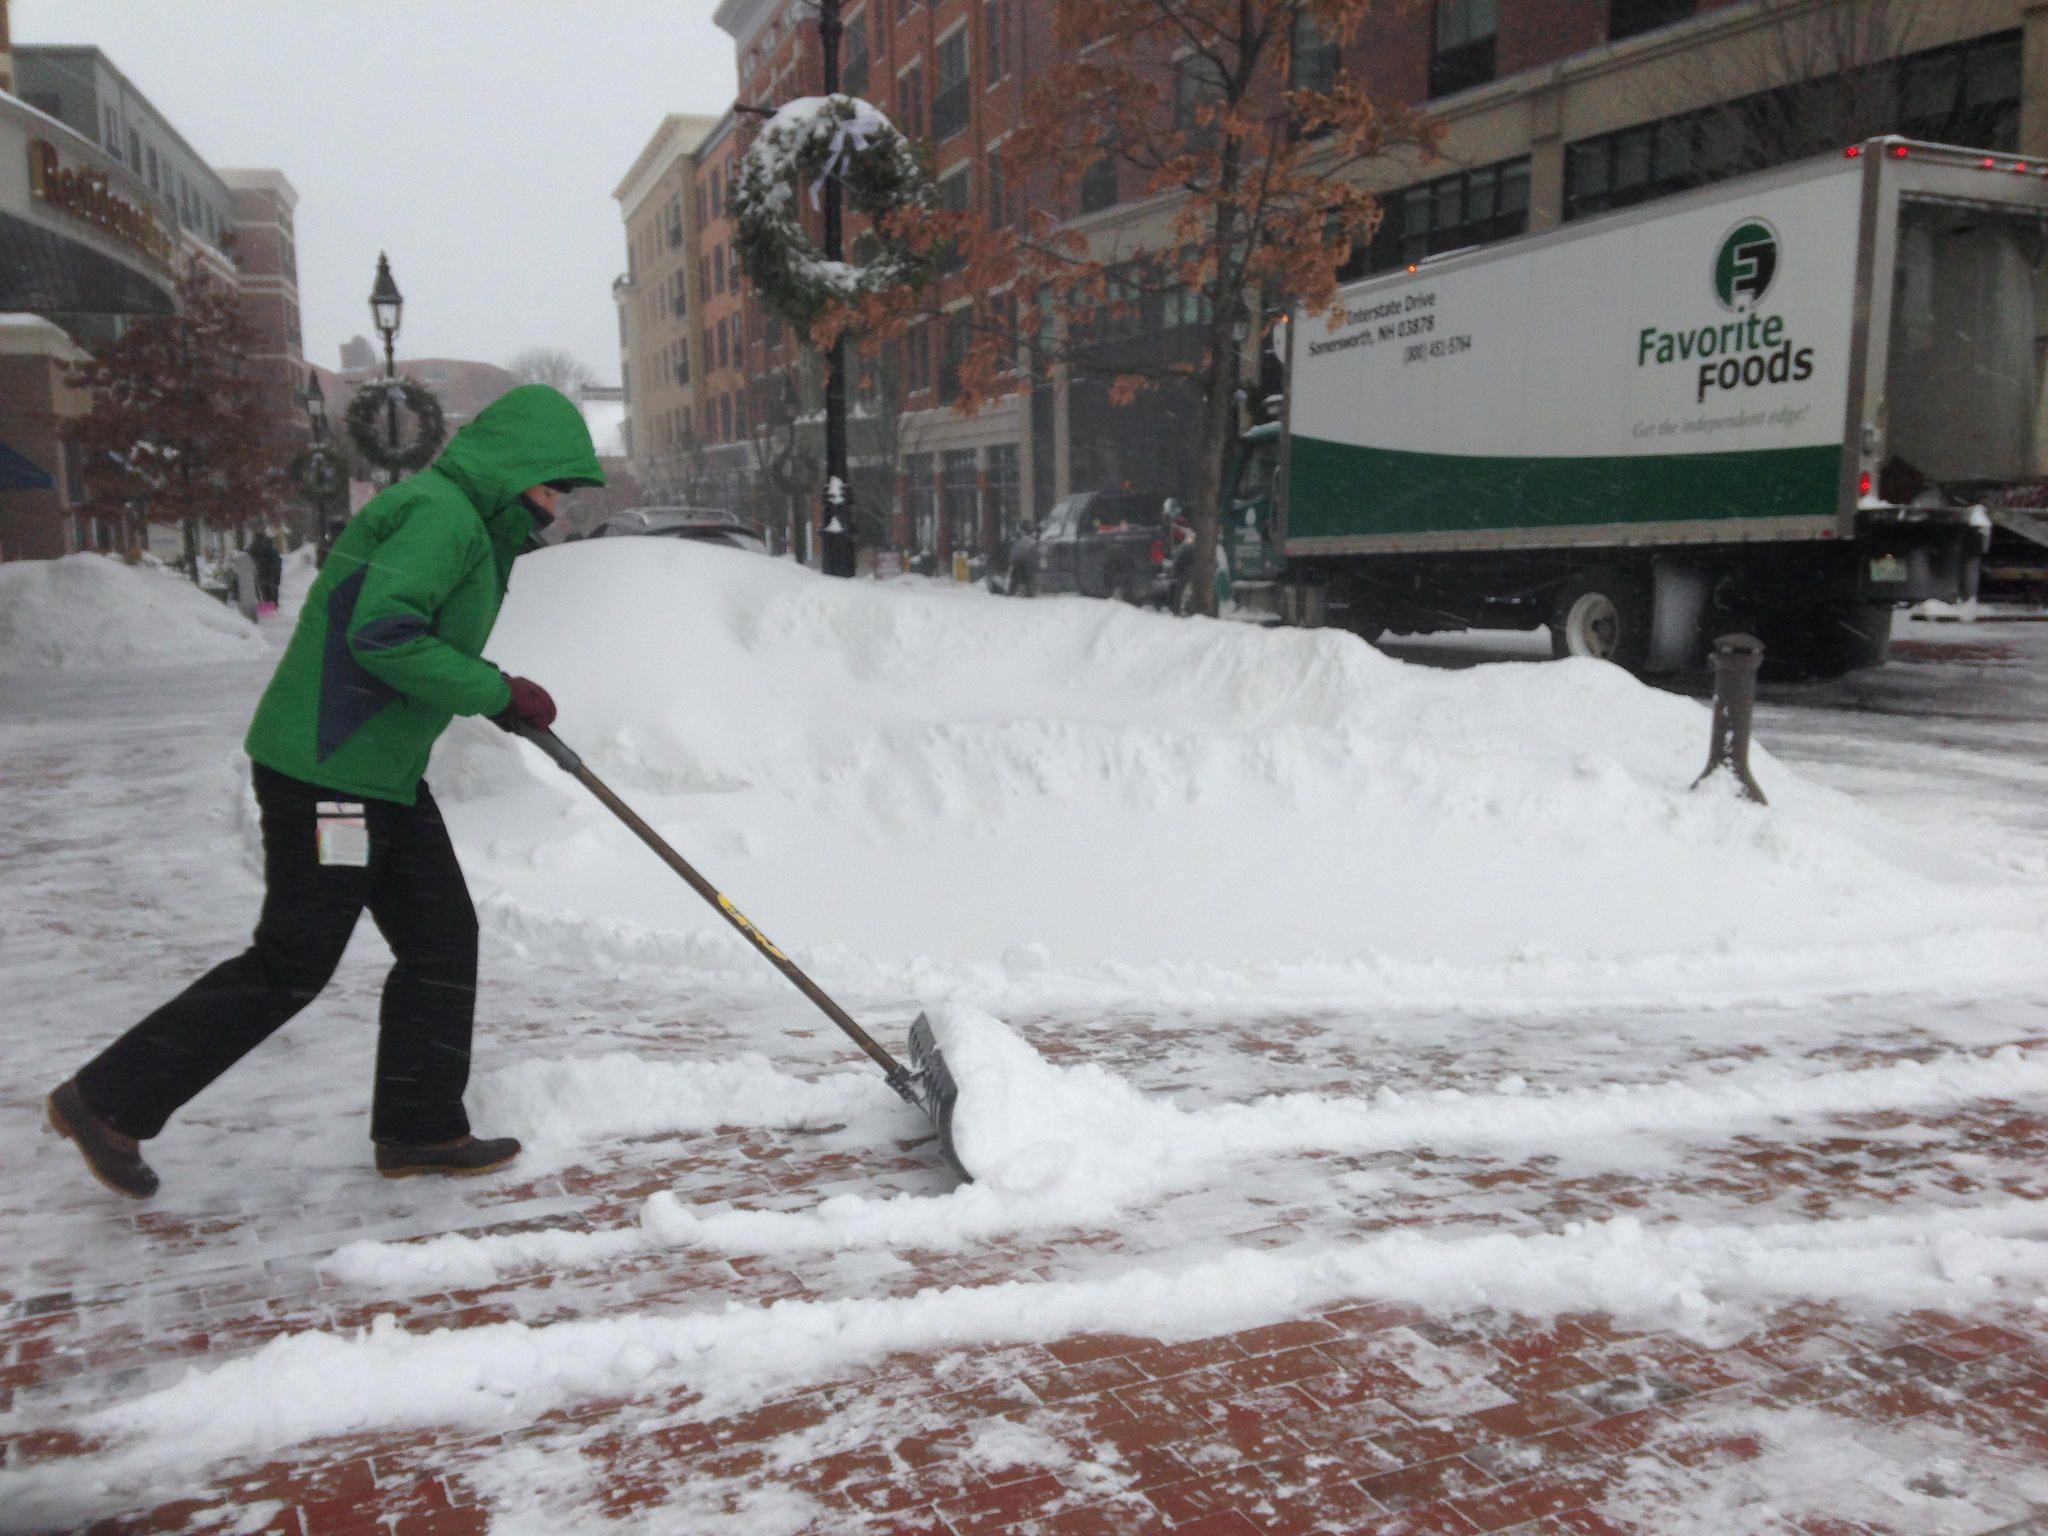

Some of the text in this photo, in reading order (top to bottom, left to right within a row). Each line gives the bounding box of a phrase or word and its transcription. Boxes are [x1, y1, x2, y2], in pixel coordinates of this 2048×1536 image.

[1405, 292, 1436, 311] Drive
[1378, 323, 1394, 341] NH
[1398, 314, 1435, 338] 03878
[1638, 305, 1784, 366] Favorite
[1697, 338, 1815, 402] Foods
[1658, 417, 1679, 435] the
[1680, 410, 1766, 434] independent
